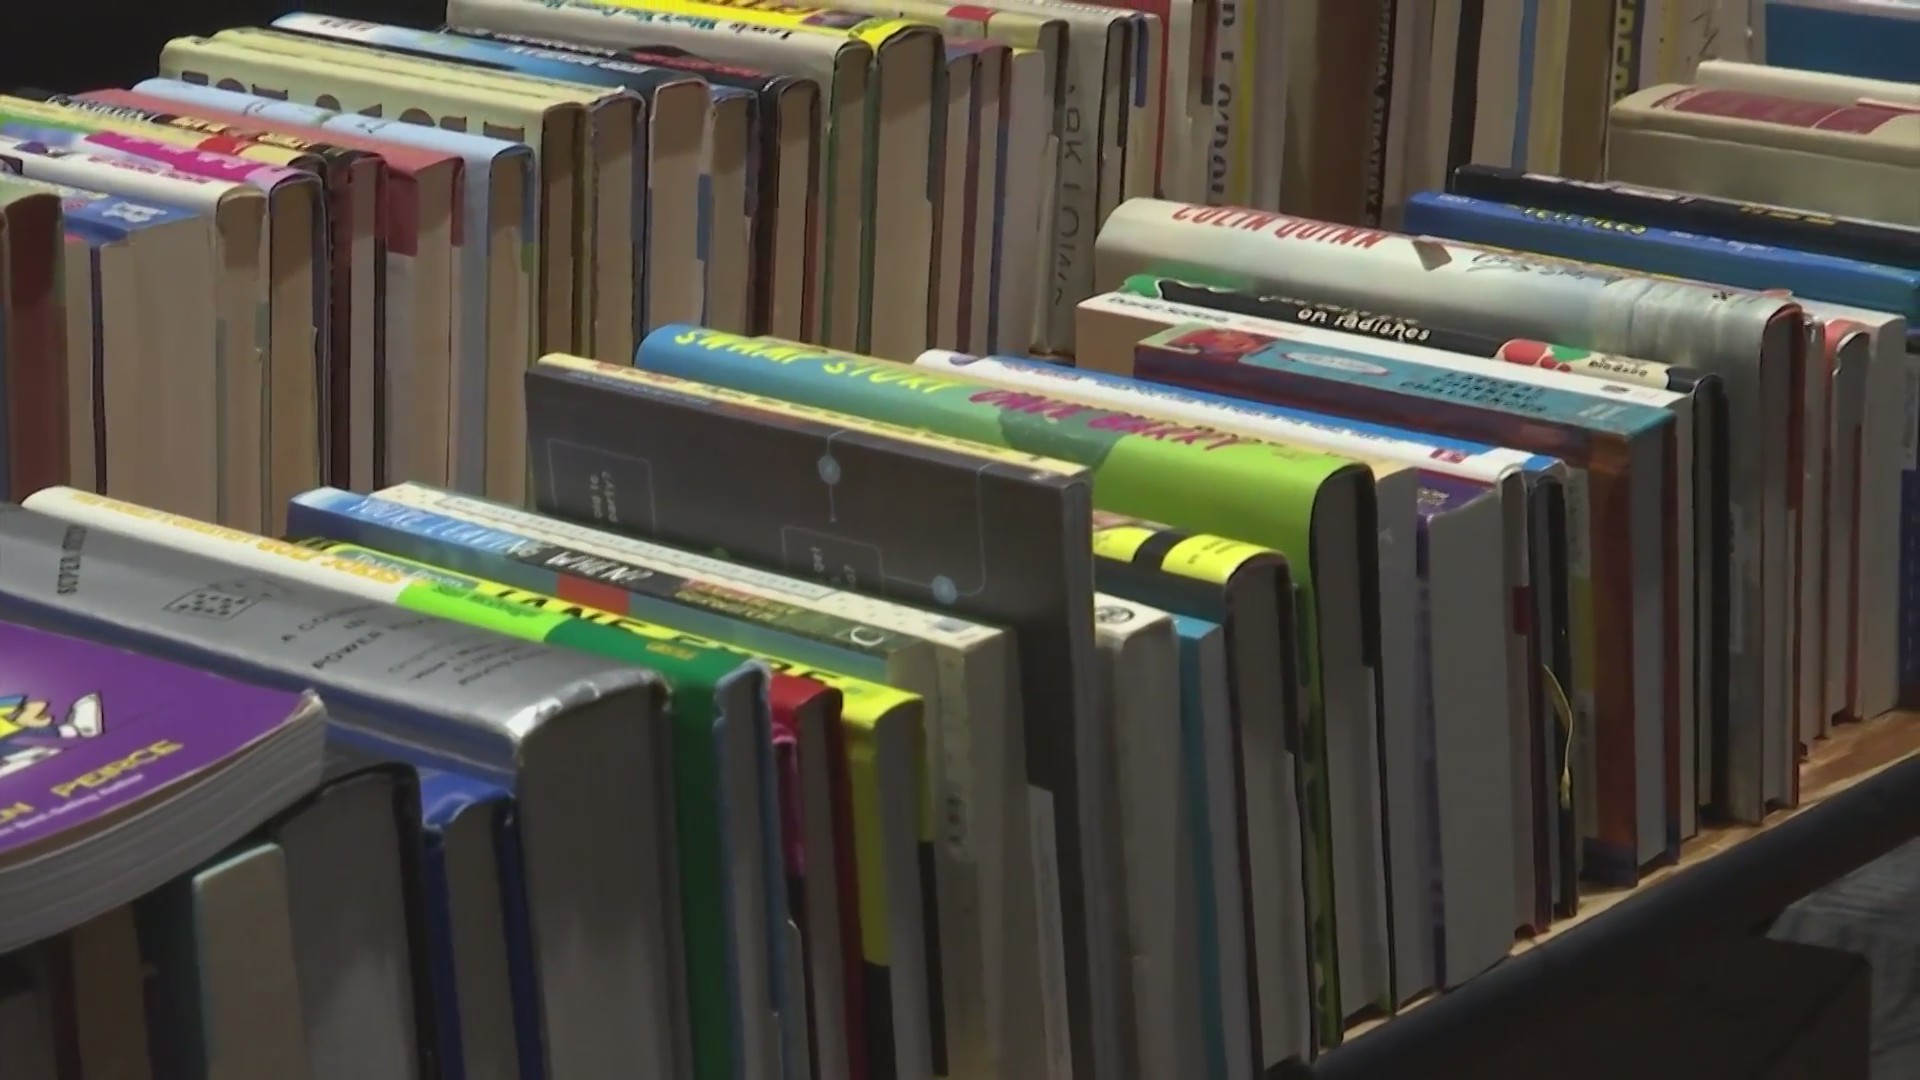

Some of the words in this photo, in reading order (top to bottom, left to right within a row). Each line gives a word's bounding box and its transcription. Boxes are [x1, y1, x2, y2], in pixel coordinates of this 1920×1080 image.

[1172, 206, 1276, 231] COLIN
[1274, 222, 1387, 249] QUINN
[1298, 308, 1328, 324] on
